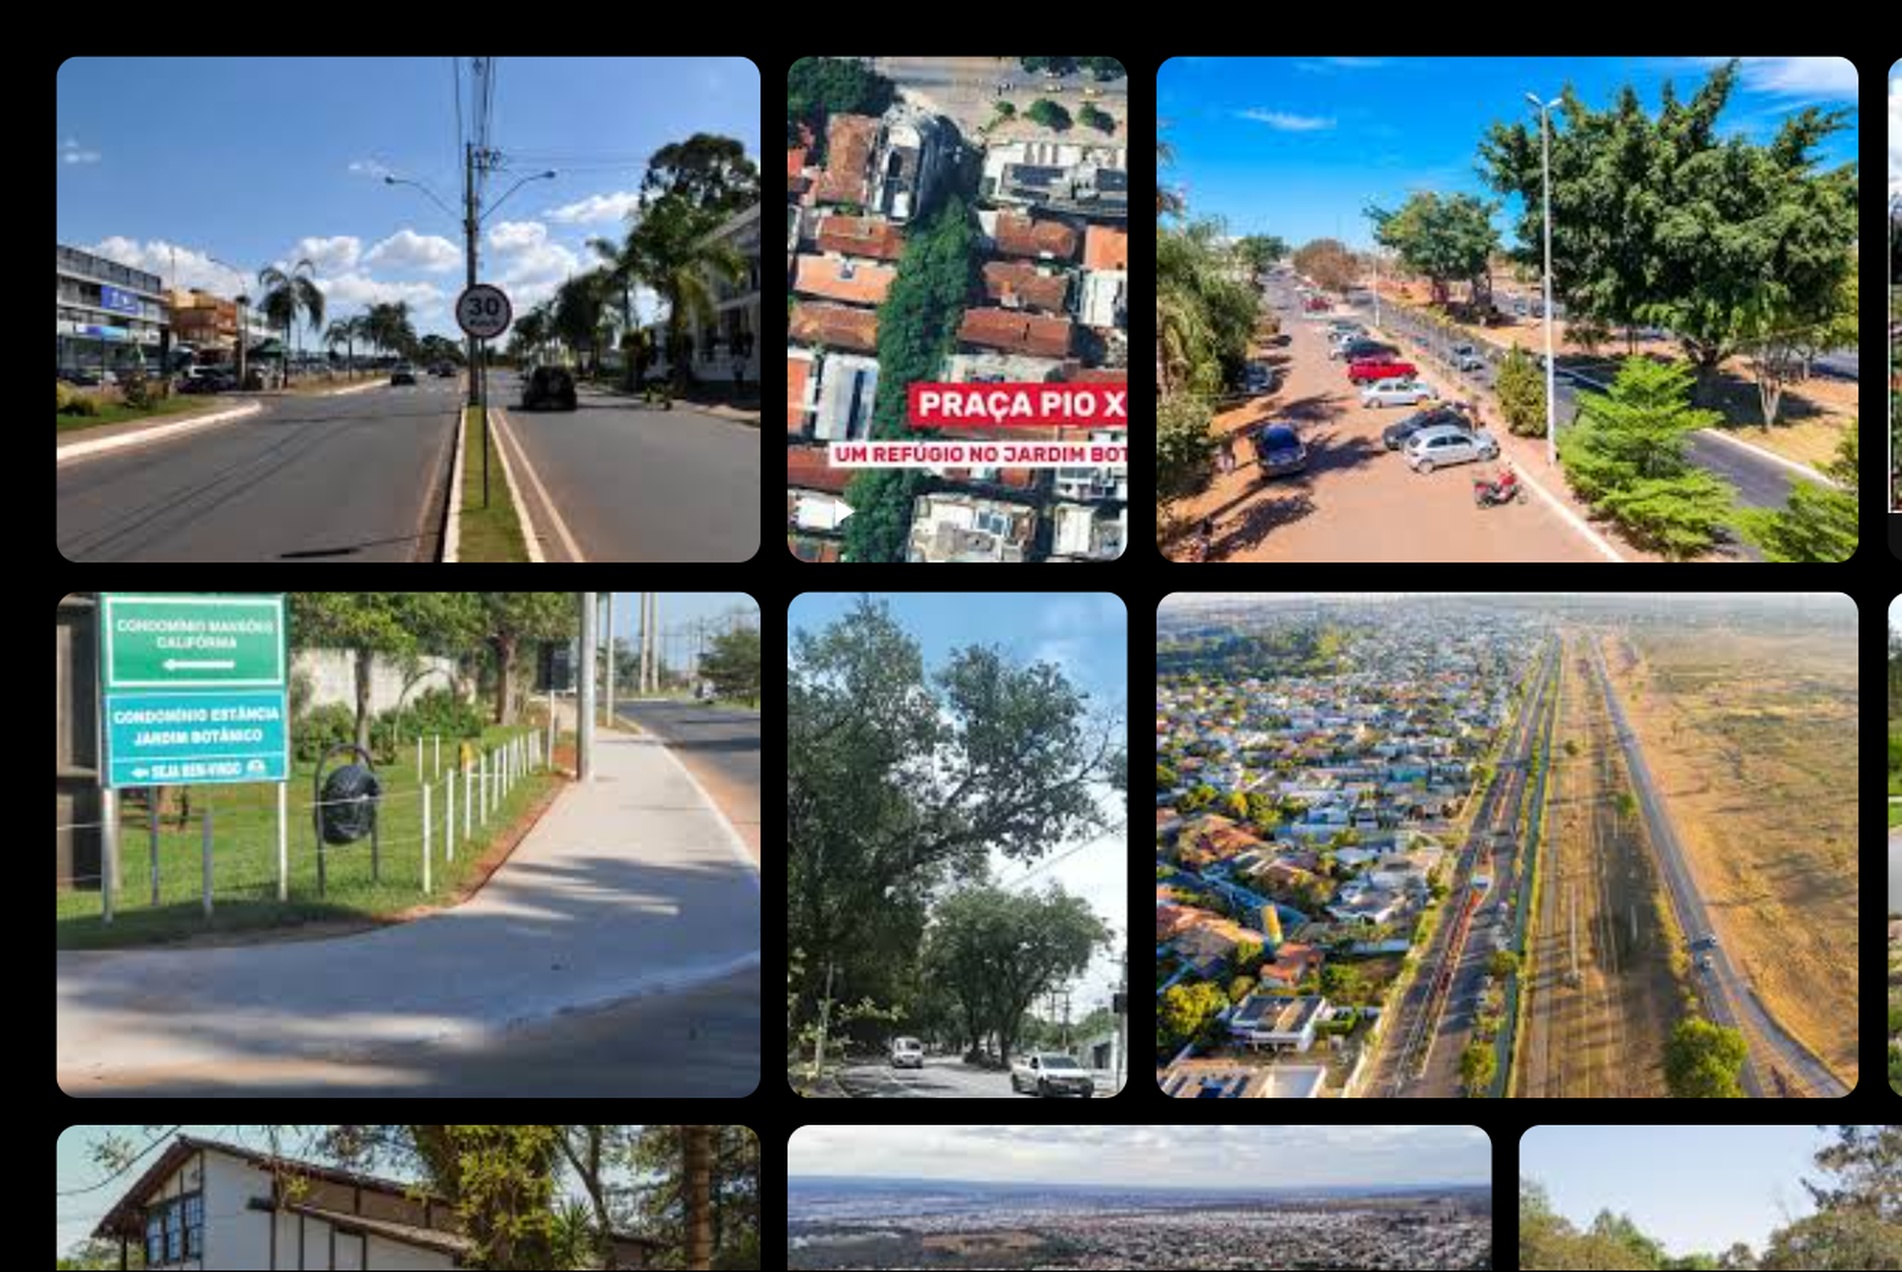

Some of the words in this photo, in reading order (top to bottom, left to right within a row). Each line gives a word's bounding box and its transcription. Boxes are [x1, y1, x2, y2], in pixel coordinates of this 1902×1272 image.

[469, 297, 500, 316] 30
[114, 706, 208, 725] CONDOMÍNIO
[211, 704, 280, 722] ESTÂNCIA
[134, 730, 188, 747] JARDIM
[191, 726, 263, 744] BOTÂNICO
